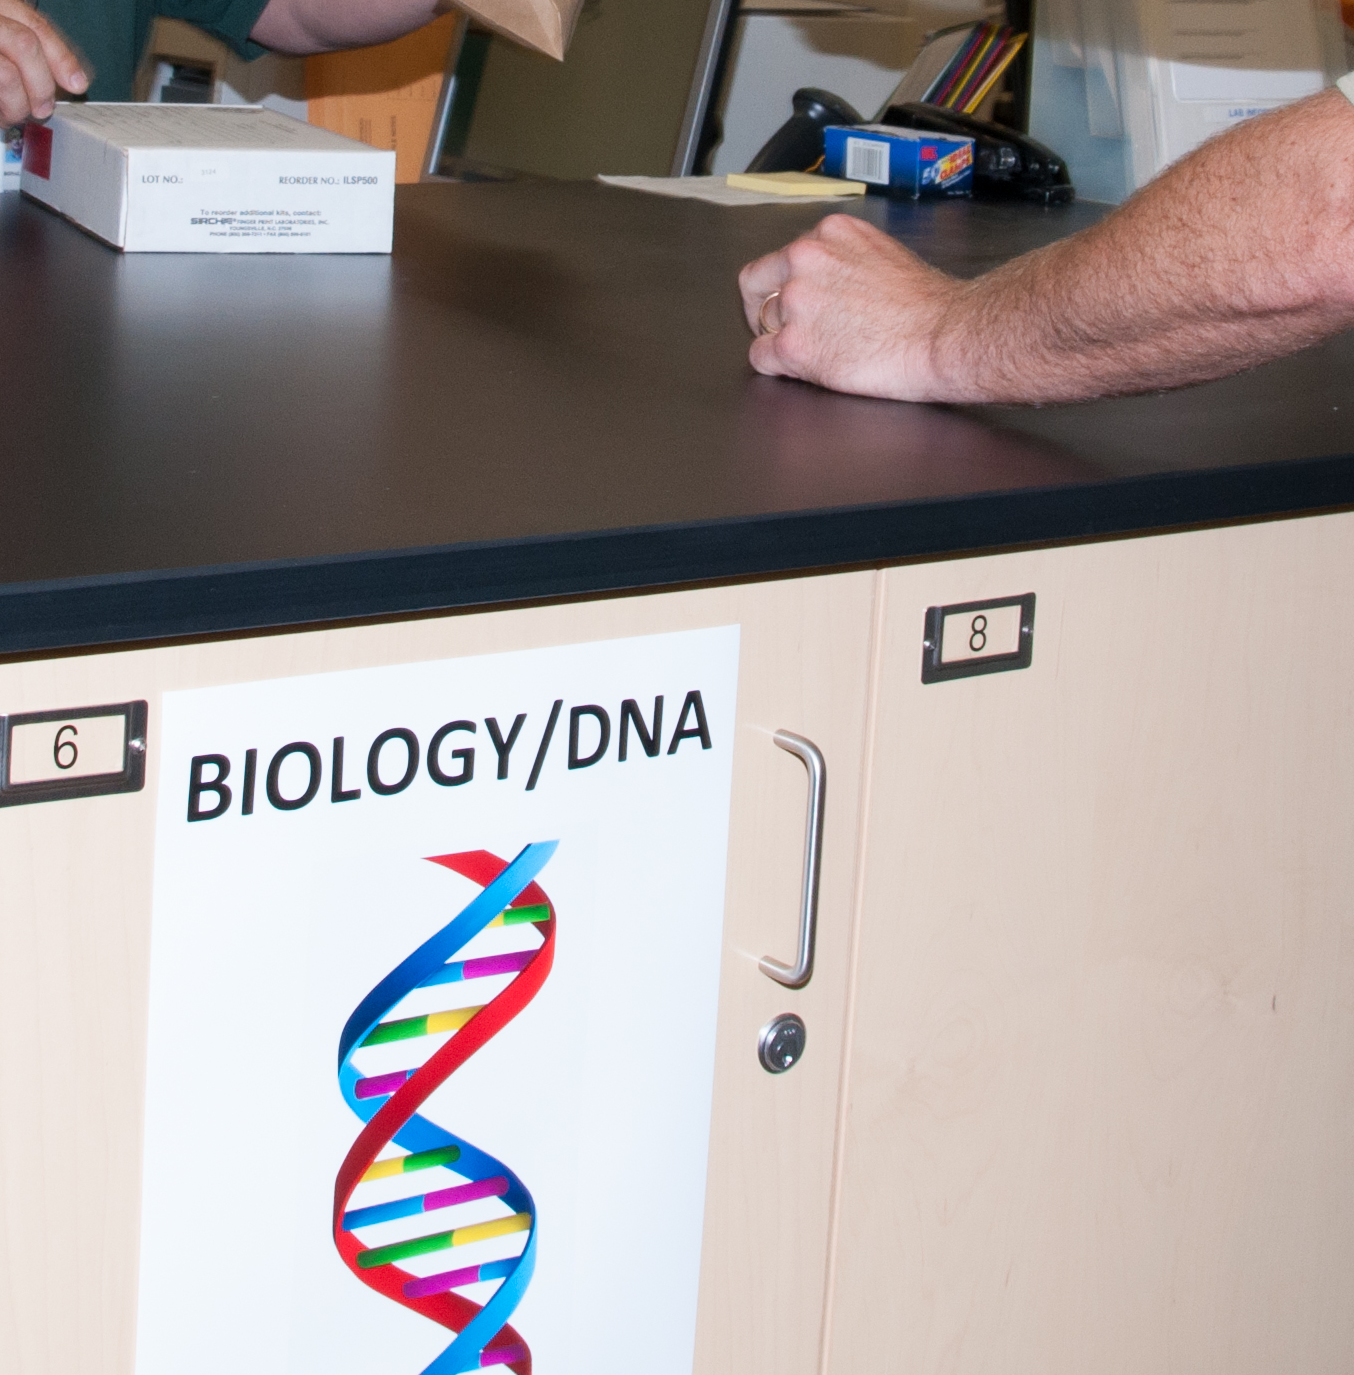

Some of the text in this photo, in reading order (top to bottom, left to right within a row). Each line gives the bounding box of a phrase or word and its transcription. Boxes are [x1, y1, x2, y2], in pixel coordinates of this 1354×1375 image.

[142, 175, 184, 184] LOT NO.:
[279, 176, 378, 185] REORDER NO.: ILSP500
[969, 614, 987, 652] 8
[51, 723, 80, 771] 6
[184, 688, 714, 823] BIOLOGY/DNA
